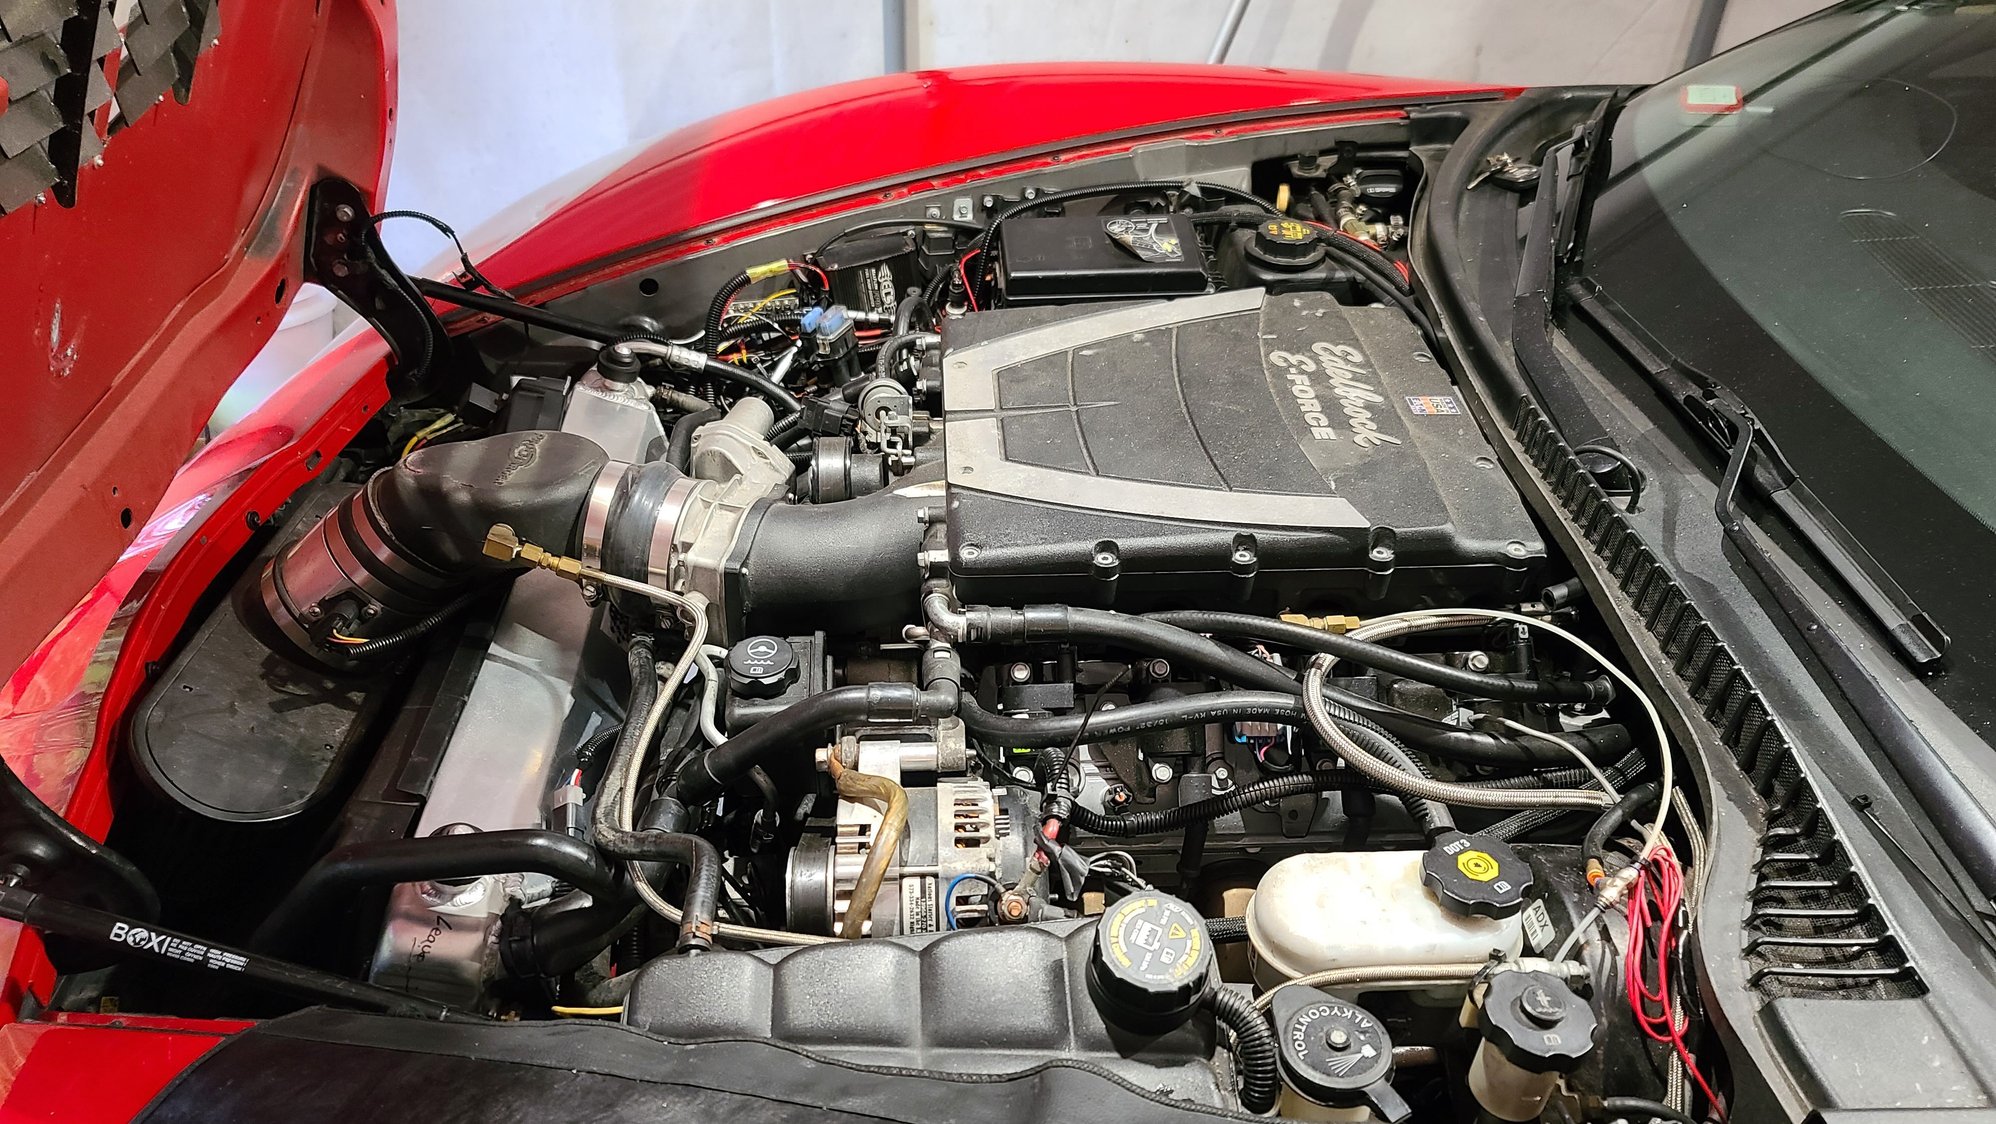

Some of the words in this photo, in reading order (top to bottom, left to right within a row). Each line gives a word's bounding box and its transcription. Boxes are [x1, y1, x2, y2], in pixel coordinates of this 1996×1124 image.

[1312, 342, 1402, 448] Edelbrock
[1210, 708, 1228, 717] USA
[1232, 707, 1242, 715] IN
[1246, 707, 1270, 715] MADE
[1274, 708, 1297, 717] HOSE
[1532, 905, 1549, 933] ADX
